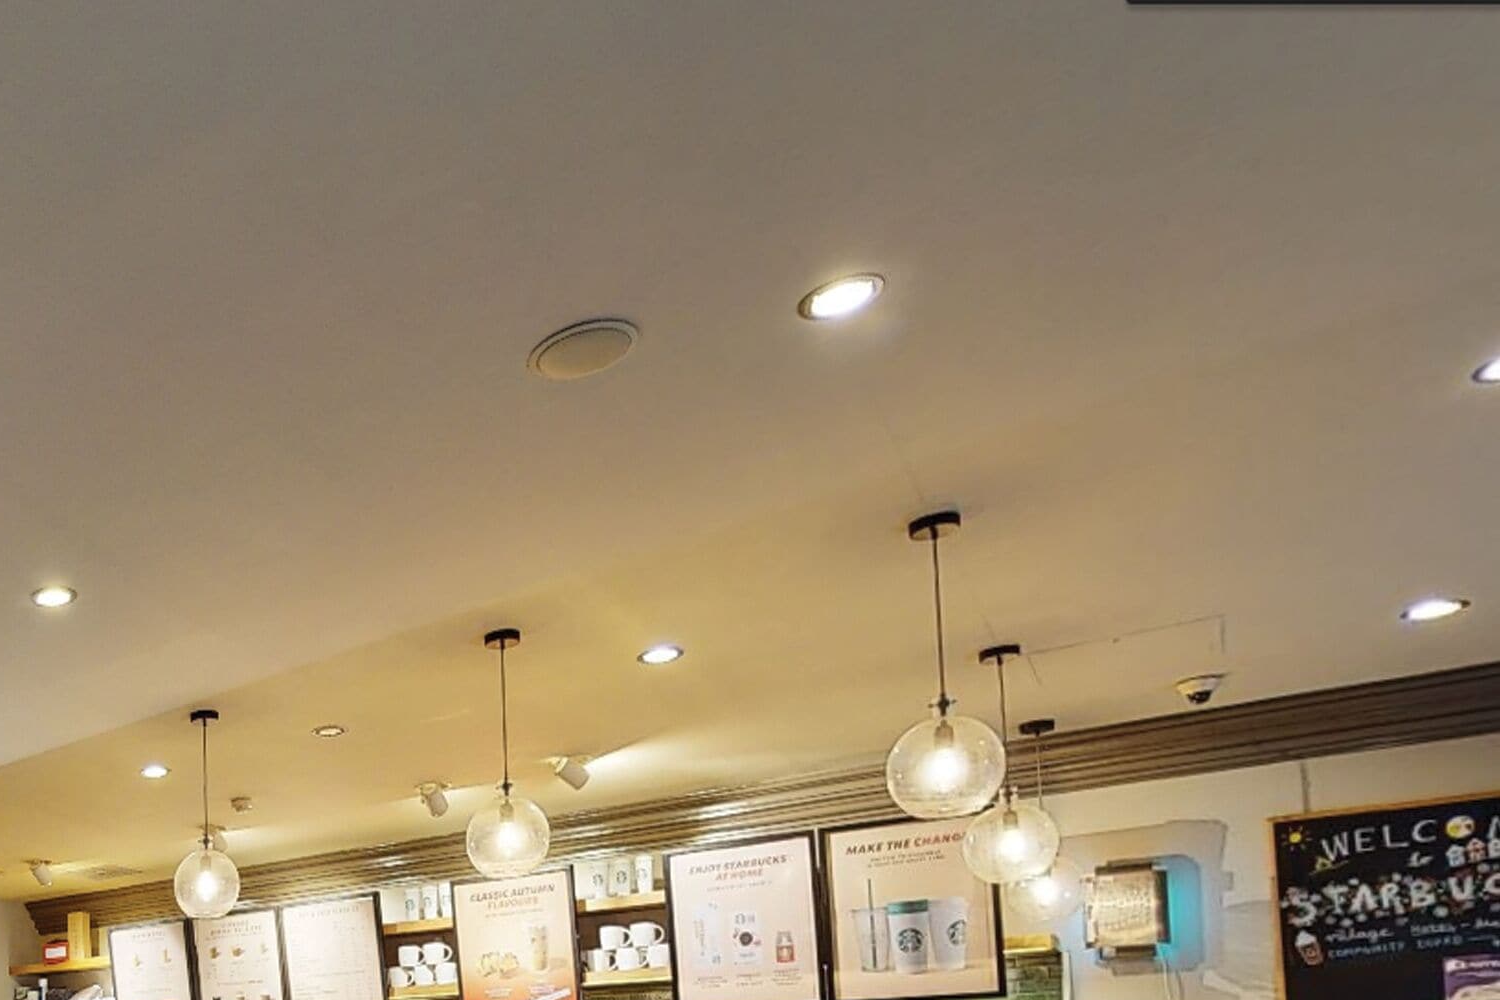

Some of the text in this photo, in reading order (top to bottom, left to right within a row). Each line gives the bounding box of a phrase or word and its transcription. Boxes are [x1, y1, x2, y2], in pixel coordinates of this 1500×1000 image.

[846, 842, 884, 855] MAKE
[887, 838, 910, 851] THE
[689, 855, 787, 875] ENJOY STARBUCKS
[716, 869, 763, 880] AT HOME
[470, 884, 555, 902] CLASSIC AUTUMN
